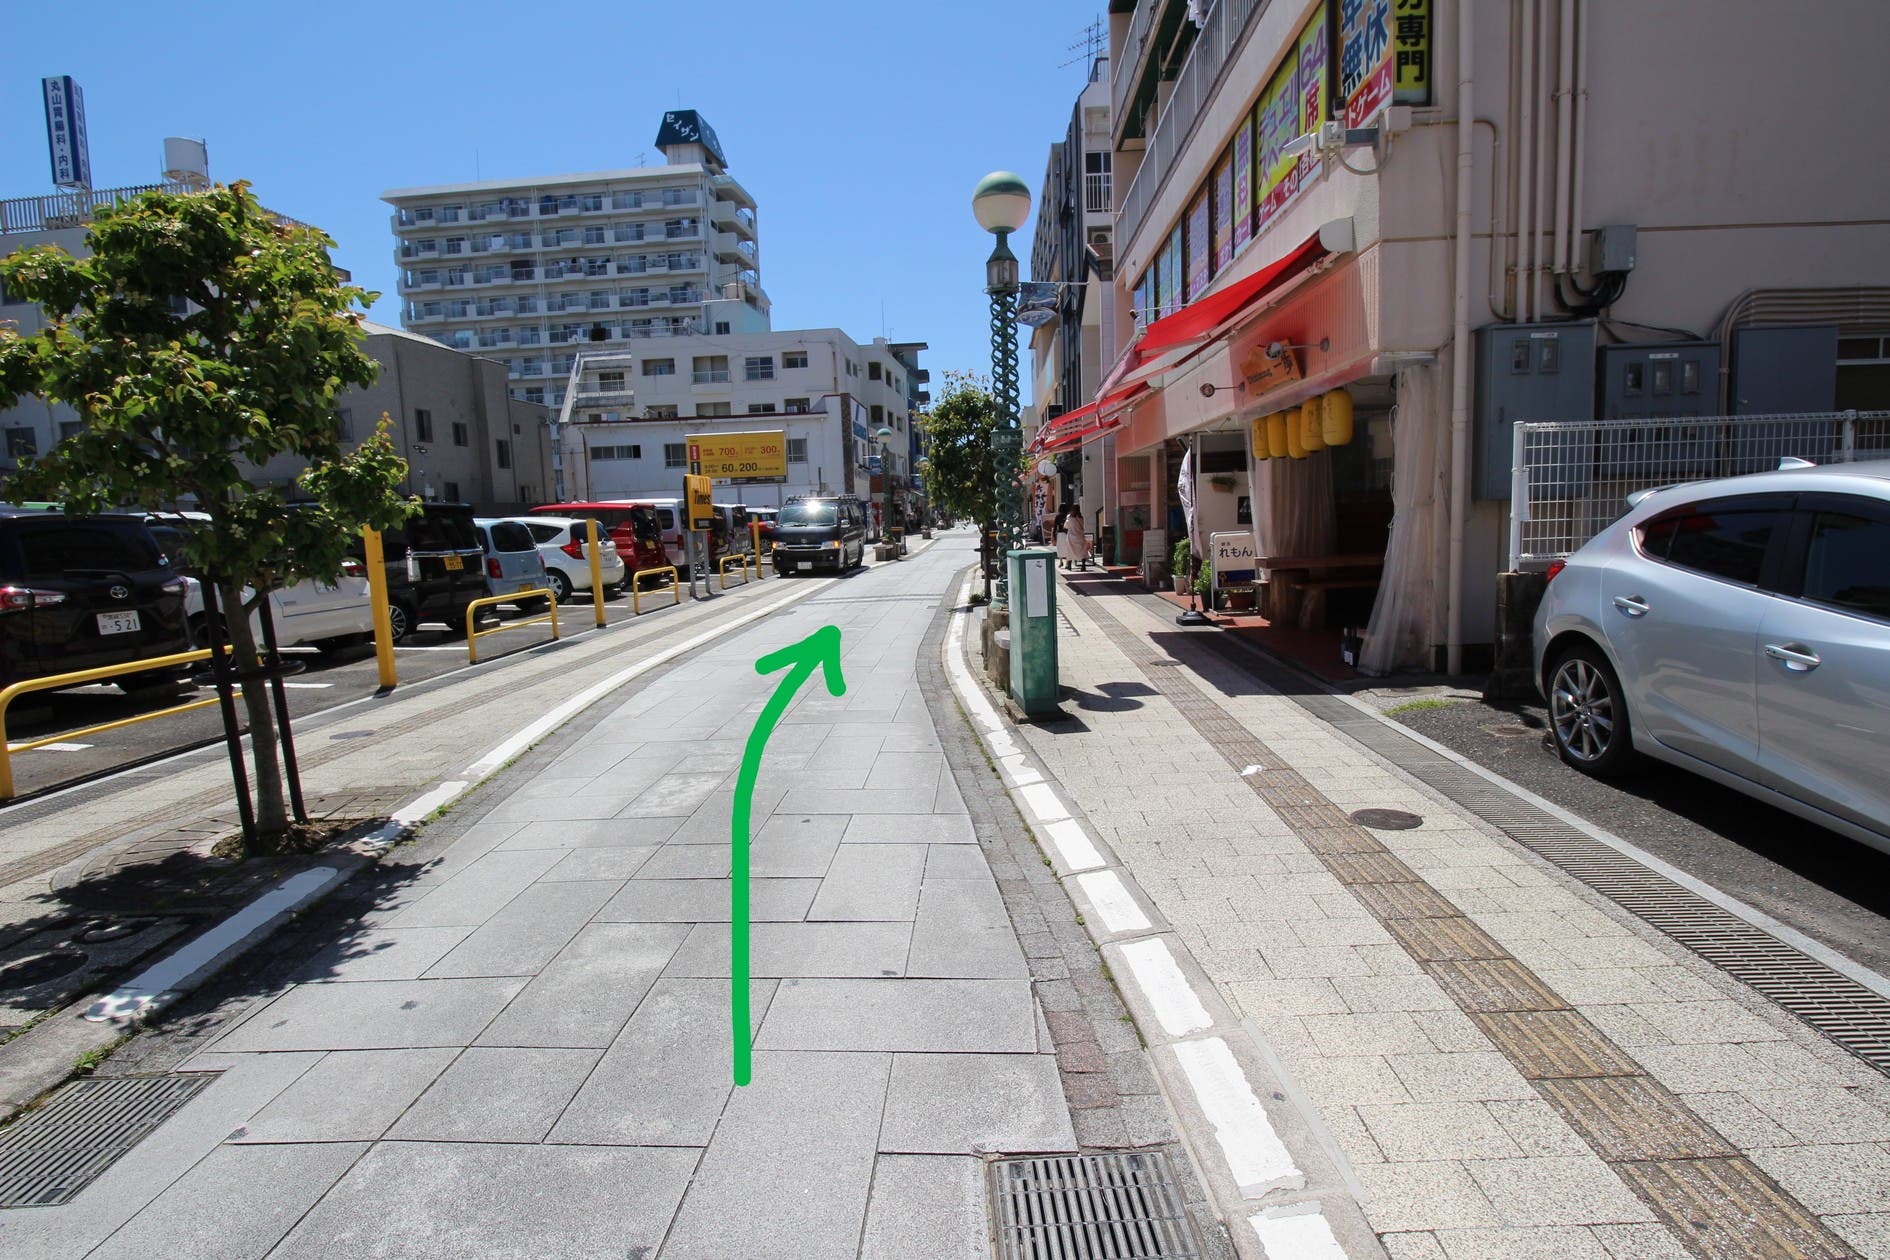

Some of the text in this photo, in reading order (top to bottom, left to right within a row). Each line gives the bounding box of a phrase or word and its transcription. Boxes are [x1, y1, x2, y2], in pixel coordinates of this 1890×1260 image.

[719, 447, 735, 456] 700
[760, 445, 777, 454] 300
[721, 463, 734, 472] 60
[739, 462, 757, 472] 200
[1219, 546, 1253, 558] れもん
